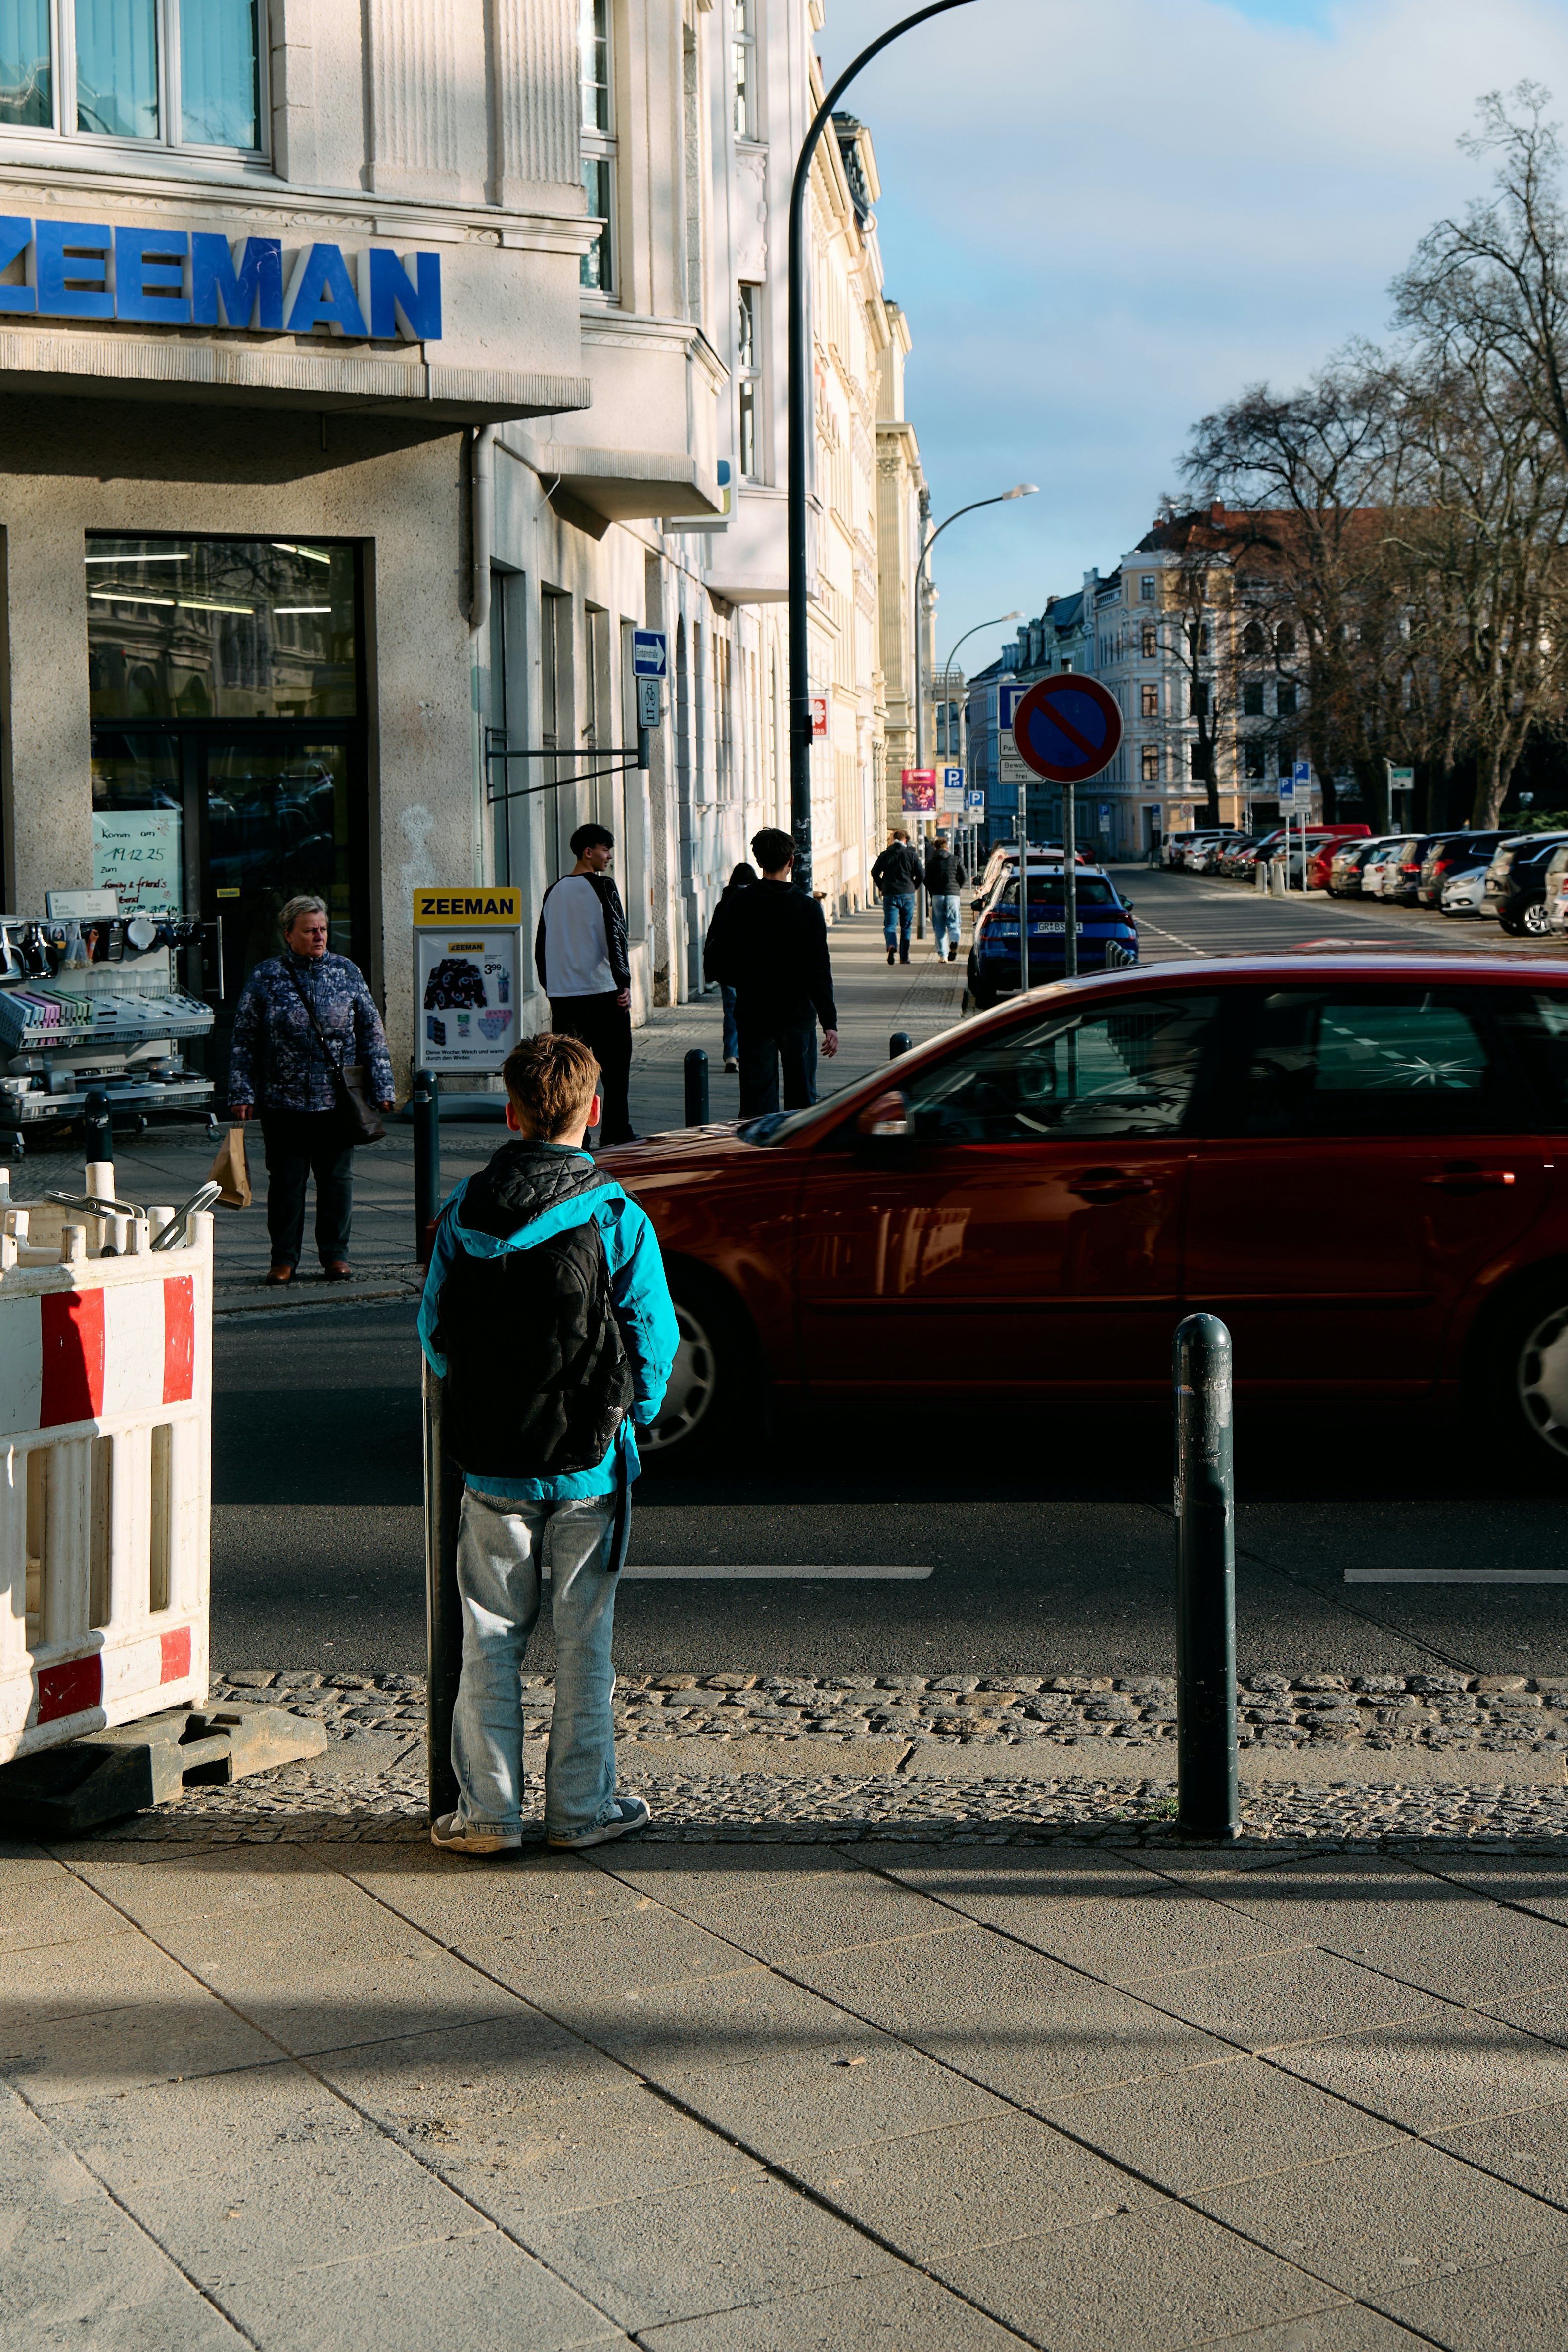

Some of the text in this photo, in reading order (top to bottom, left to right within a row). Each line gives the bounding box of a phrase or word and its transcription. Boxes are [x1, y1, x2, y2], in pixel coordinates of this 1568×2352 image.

[1295, 764, 1303, 774] P
[948, 770, 960, 786] P
[1281, 779, 1289, 788] P
[972, 793, 980, 804] P
[421, 898, 513, 914] ZEEMAN
